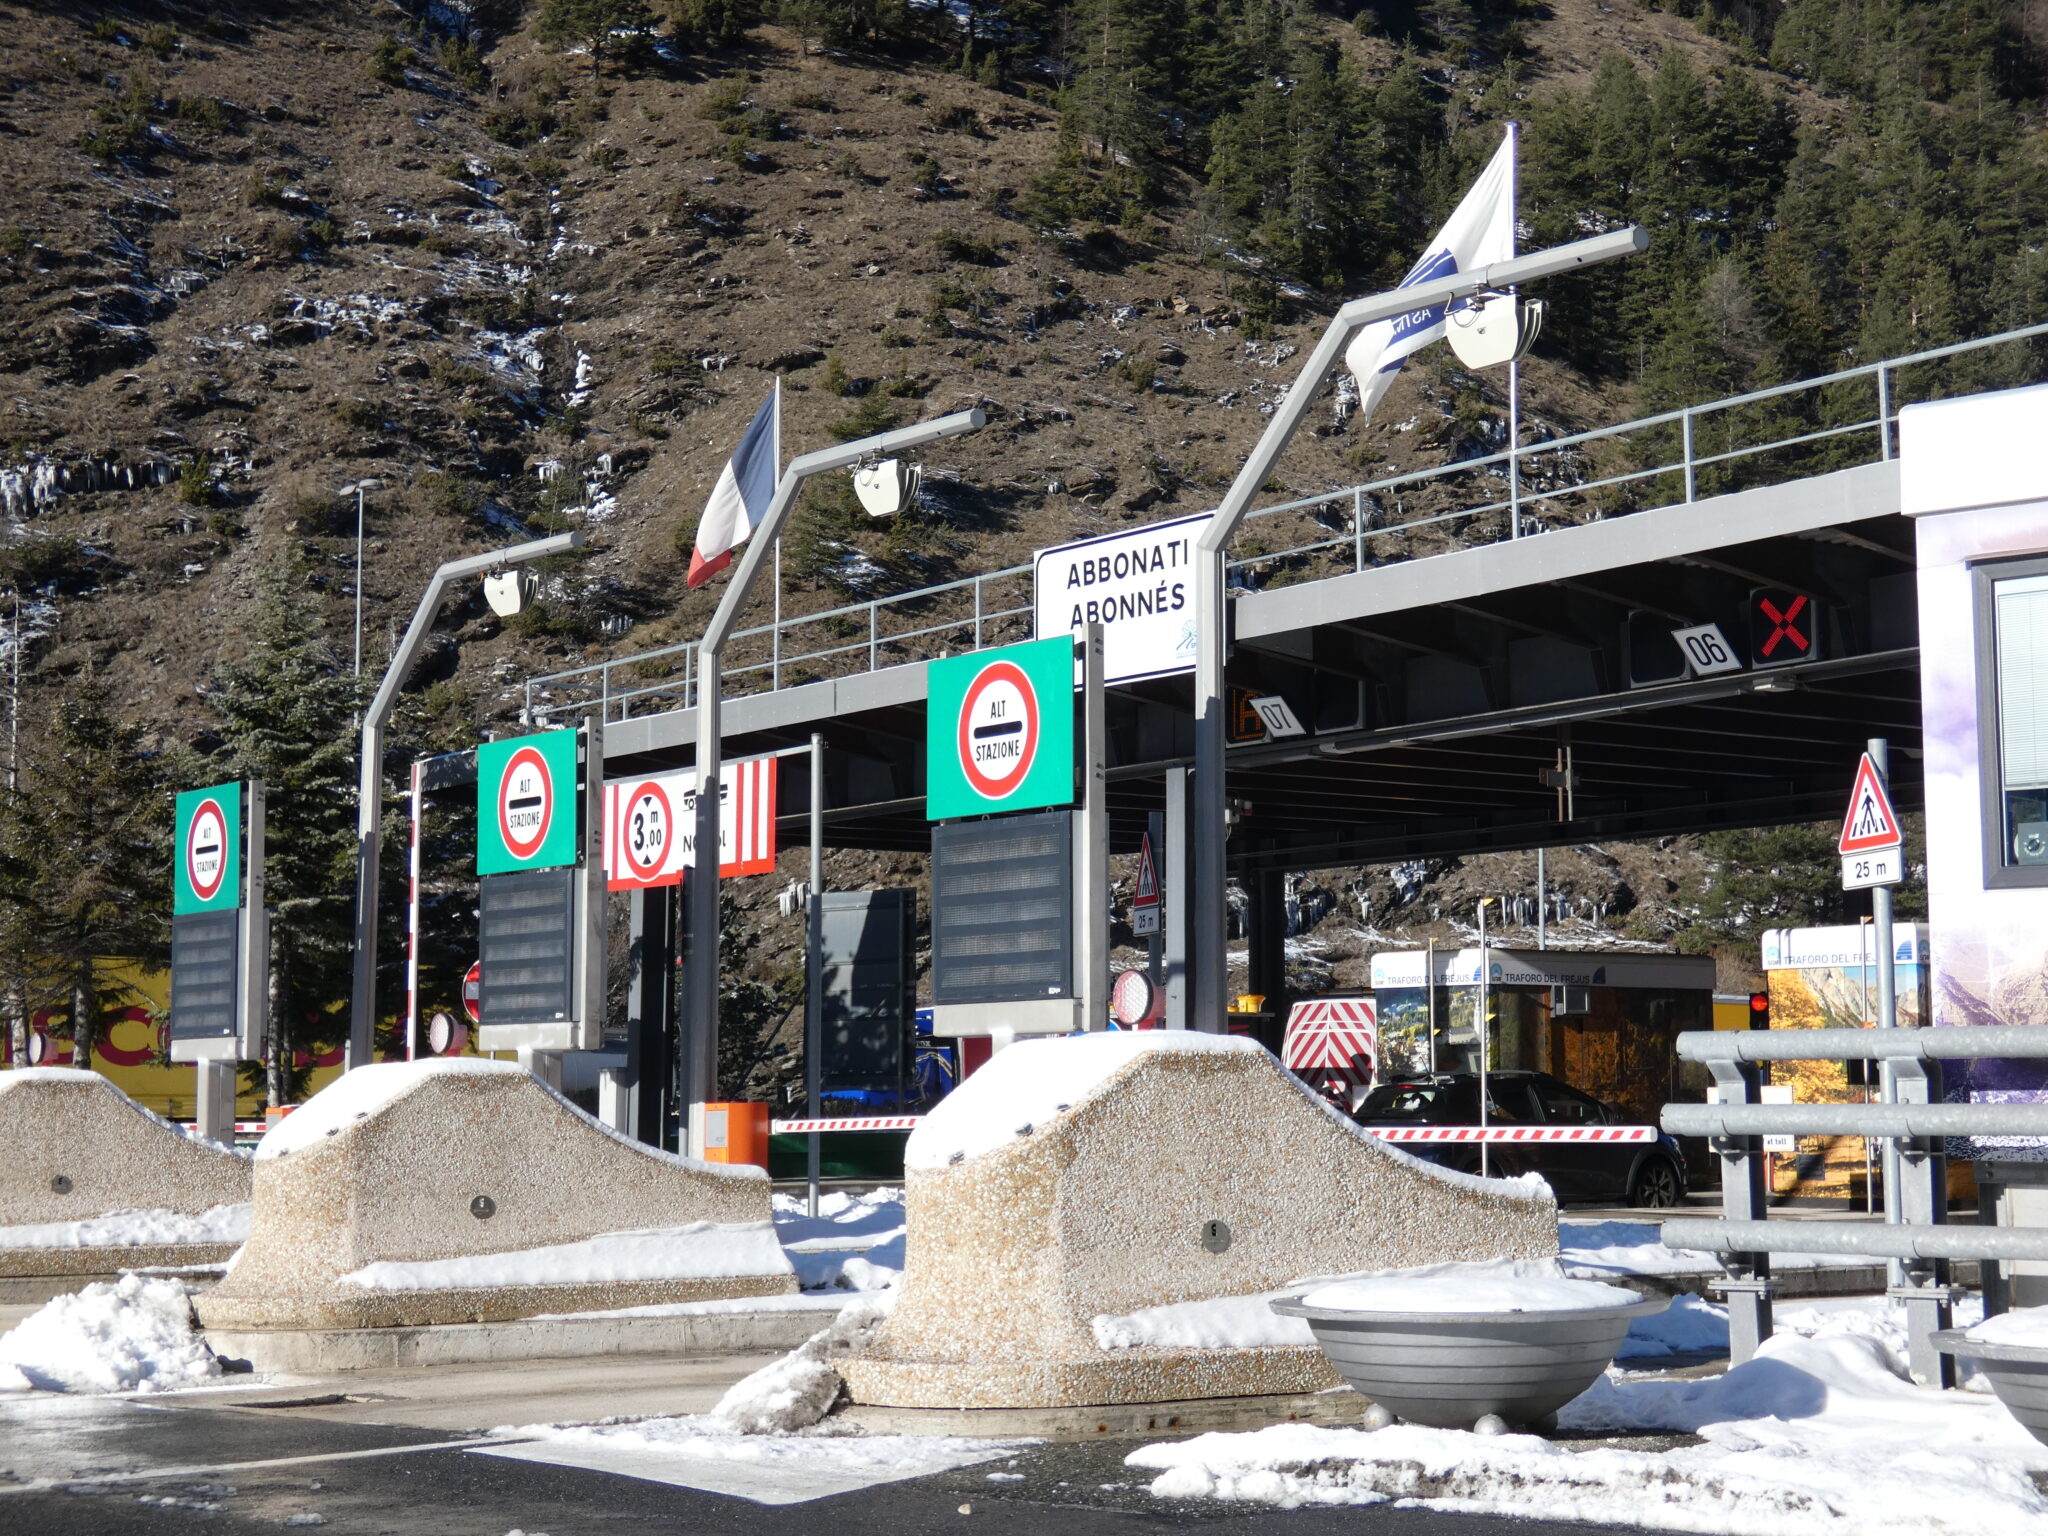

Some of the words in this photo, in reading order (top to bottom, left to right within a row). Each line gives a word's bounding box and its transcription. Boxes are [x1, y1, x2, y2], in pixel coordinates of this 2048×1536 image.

[1067, 539, 1188, 589] ABBONATI
[1071, 580, 1185, 630] ABONNÉS
[1685, 633, 1728, 666] 06
[990, 700, 1006, 719] ALT
[1261, 704, 1292, 730] 07
[976, 740, 1020, 762] STAZIONE
[520, 779, 531, 793] ALT
[510, 811, 540, 829] STAZIONE
[203, 827, 212, 839] ALT
[634, 813, 662, 851] 3,00
[650, 811, 659, 824] m
[196, 859, 218, 873] STAZIONE
[1855, 861, 1870, 879] 25
[1876, 862, 1887, 875] m
[1138, 915, 1146, 929] 25
[1147, 916, 1154, 927] m
[1784, 953, 1829, 965] TRAFORO
[1832, 954, 1850, 963] DEL
[1387, 975, 1423, 985] TRAFORO
[1424, 975, 1439, 984] DL
[1505, 973, 1543, 983] TRAFORO
[1544, 974, 1559, 983] DEL
